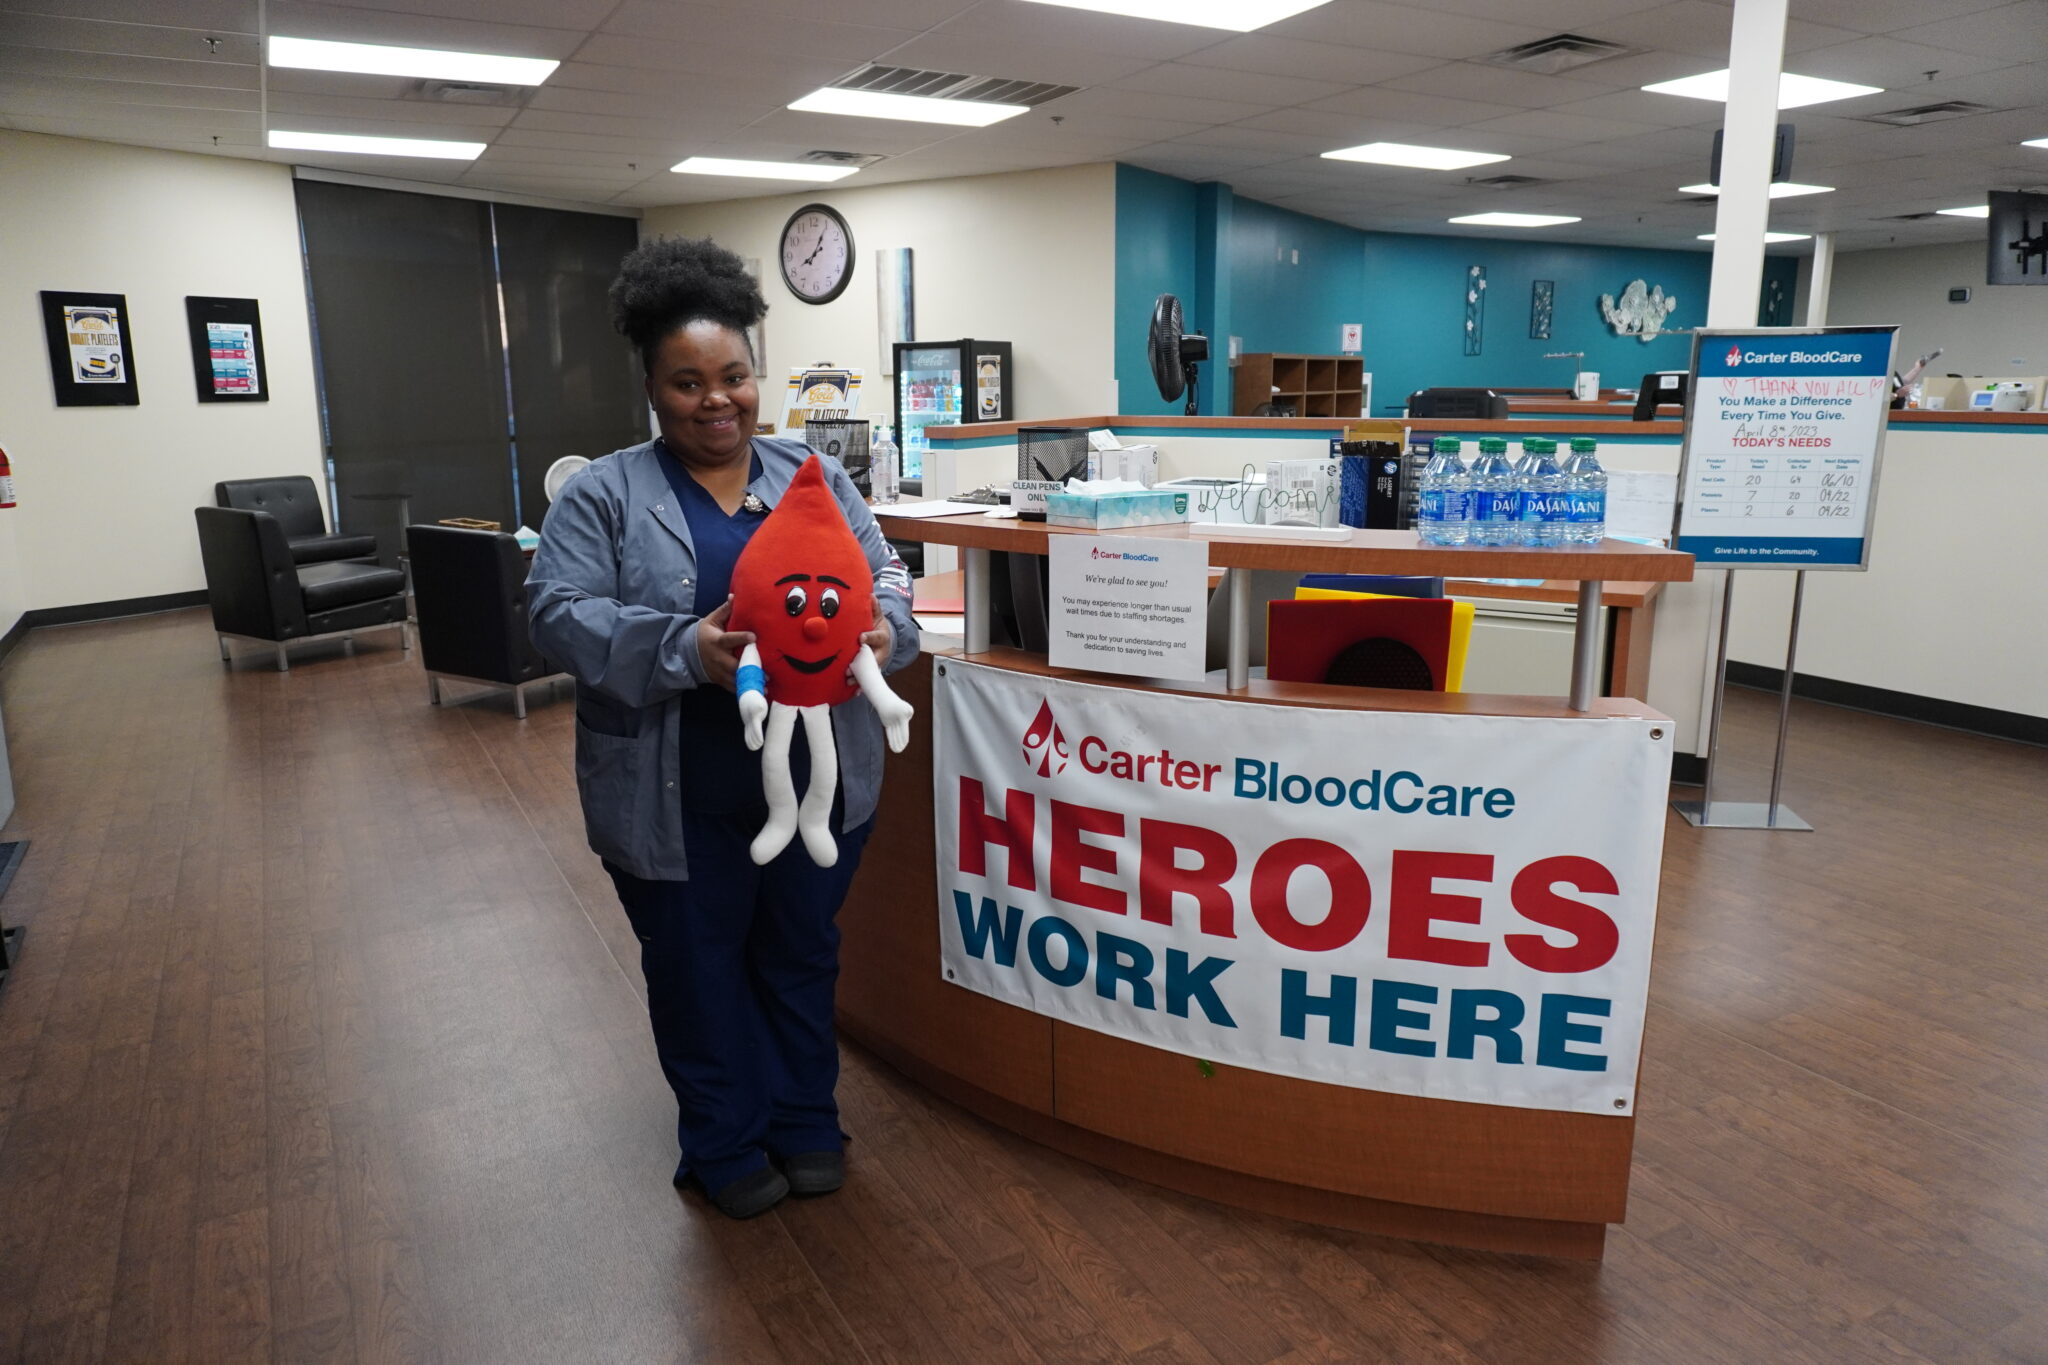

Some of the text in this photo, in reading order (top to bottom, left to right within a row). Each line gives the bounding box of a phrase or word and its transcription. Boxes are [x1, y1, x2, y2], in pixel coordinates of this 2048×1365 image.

[810, 216, 818, 227] 12
[797, 223, 805, 233] 11
[833, 231, 839, 241] 2
[790, 237, 799, 247] 10
[786, 252, 793, 262] 9
[838, 247, 844, 257] 3
[791, 267, 797, 277] 8
[835, 264, 840, 274] 4
[800, 278, 806, 288] 7
[813, 281, 820, 291] 6
[826, 276, 832, 287] 5
[91, 333, 119, 346] PLATELETS
[1744, 351, 1862, 364] Carter BloodCare
[1745, 377, 1798, 396] THANK
[1804, 380, 1830, 396] YOU
[1719, 397, 1740, 406] You
[1744, 397, 1776, 406] Make
[1790, 396, 1852, 406] Difference
[1721, 411, 1845, 422] Every Time You Give.
[1735, 423, 1763, 439] April
[1789, 425, 1818, 437] 2023
[1732, 438, 1832, 447] TODAY'S NEEDS
[1384, 461, 1398, 474] hp
[1013, 482, 1037, 490] CLEAN
[1745, 475, 1761, 486] 20
[1821, 474, 1854, 487] 06/10
[1028, 493, 1048, 501] ONLY
[1747, 490, 1758, 501] 7
[1744, 505, 1753, 517] 2
[1786, 505, 1794, 516] 6
[1100, 552, 1159, 562] Carter BloodCare
[1773, 548, 1819, 556] Community.
[1085, 575, 1106, 584] We're
[1108, 576, 1124, 586] glad
[1150, 580, 1168, 588] you!
[1062, 596, 1075, 605] You
[1077, 598, 1090, 607] may
[1092, 600, 1128, 609] experience
[1131, 602, 1152, 611] longer
[1080, 608, 1098, 616] times
[1122, 612, 1147, 622] staffing
[1066, 631, 1085, 639] Thank
[1109, 635, 1123, 644] your
[1125, 636, 1172, 648] understanding
[1084, 643, 1116, 652] dedication
[1125, 647, 1146, 656] saving
[1080, 735, 1515, 819] Carter BloodCare
[959, 775, 1619, 974] HEROES
[953, 889, 1611, 1072] WORK HERE
